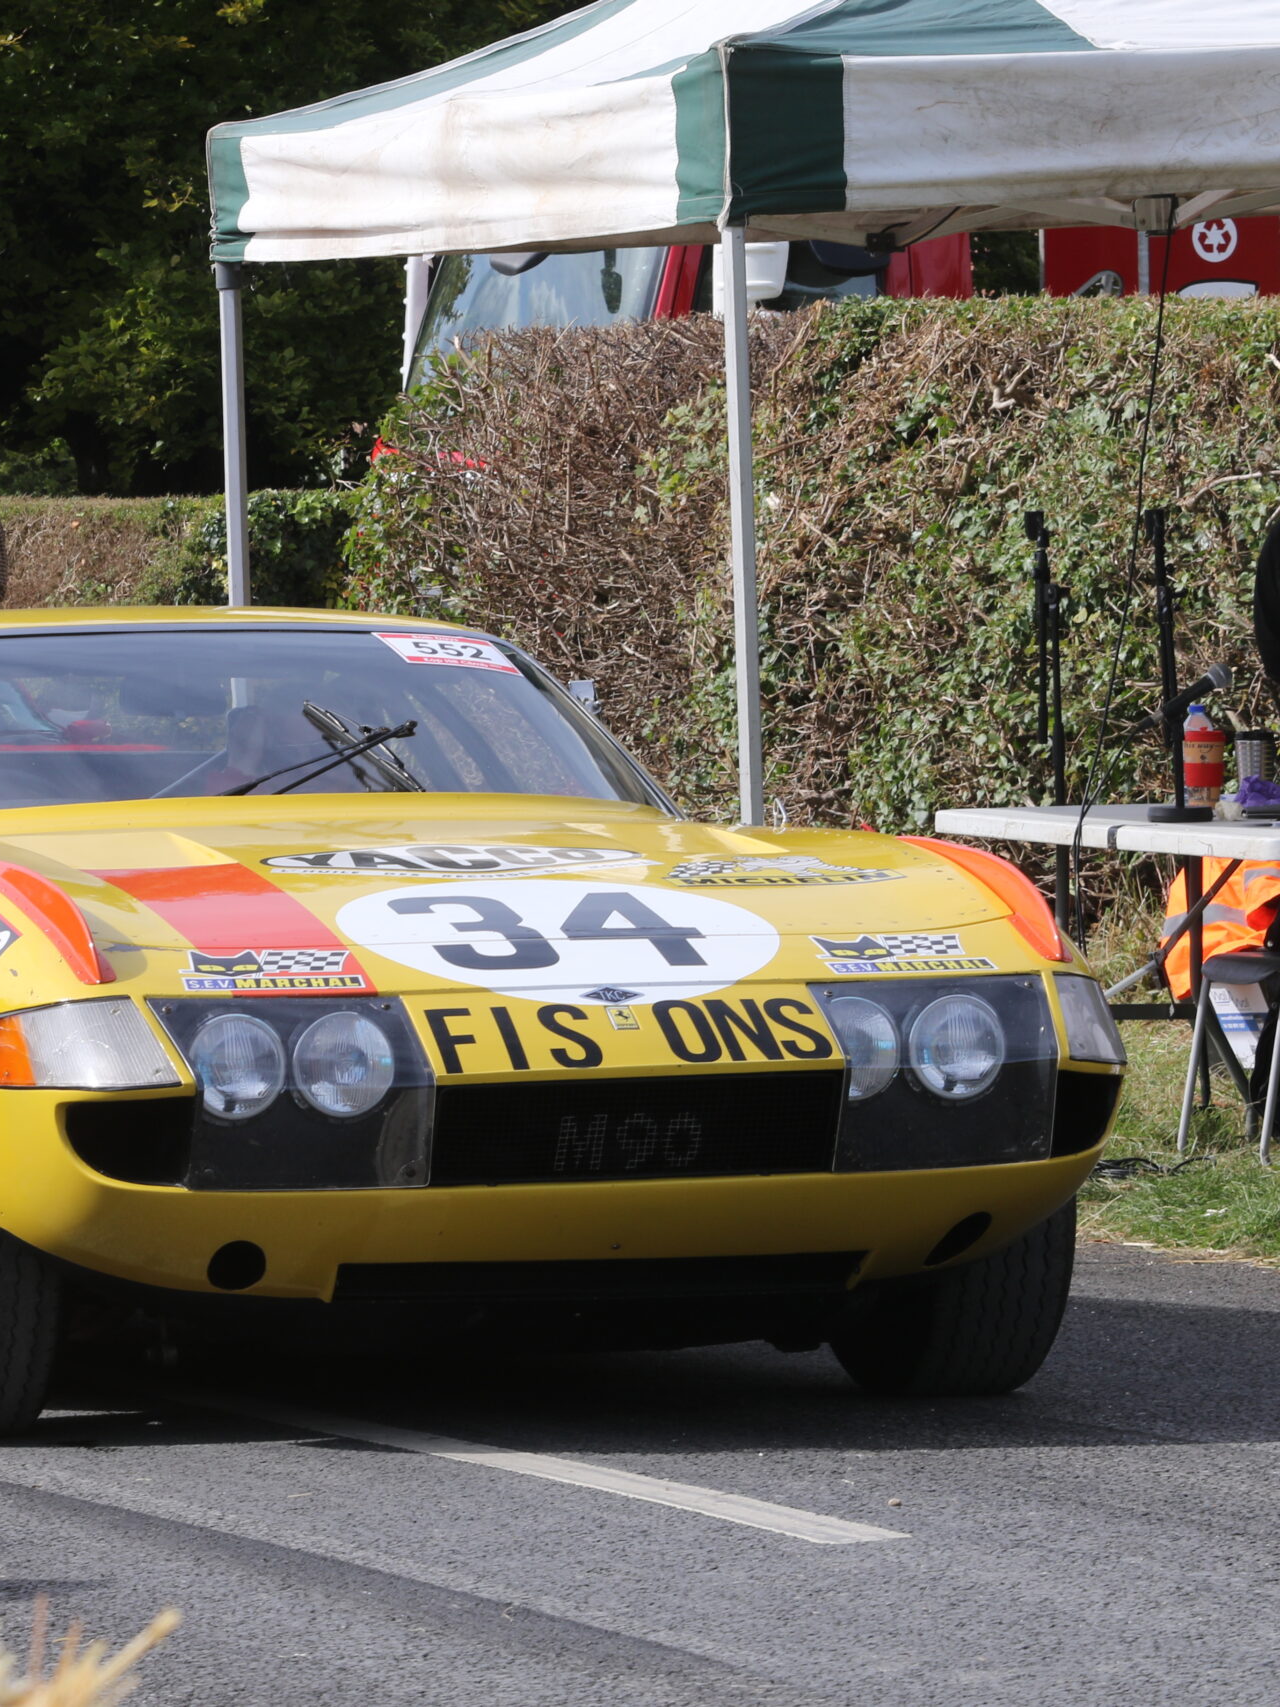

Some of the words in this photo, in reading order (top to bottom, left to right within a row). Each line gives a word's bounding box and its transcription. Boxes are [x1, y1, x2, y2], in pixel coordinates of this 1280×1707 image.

[412, 641, 492, 661] 552
[290, 845, 606, 869] YACCO
[679, 871, 891, 884] MICHELIN
[387, 891, 707, 970] 34
[875, 959, 992, 972] MARCHAL
[234, 976, 359, 989] MARCHAL
[599, 990, 625, 1001] TKC
